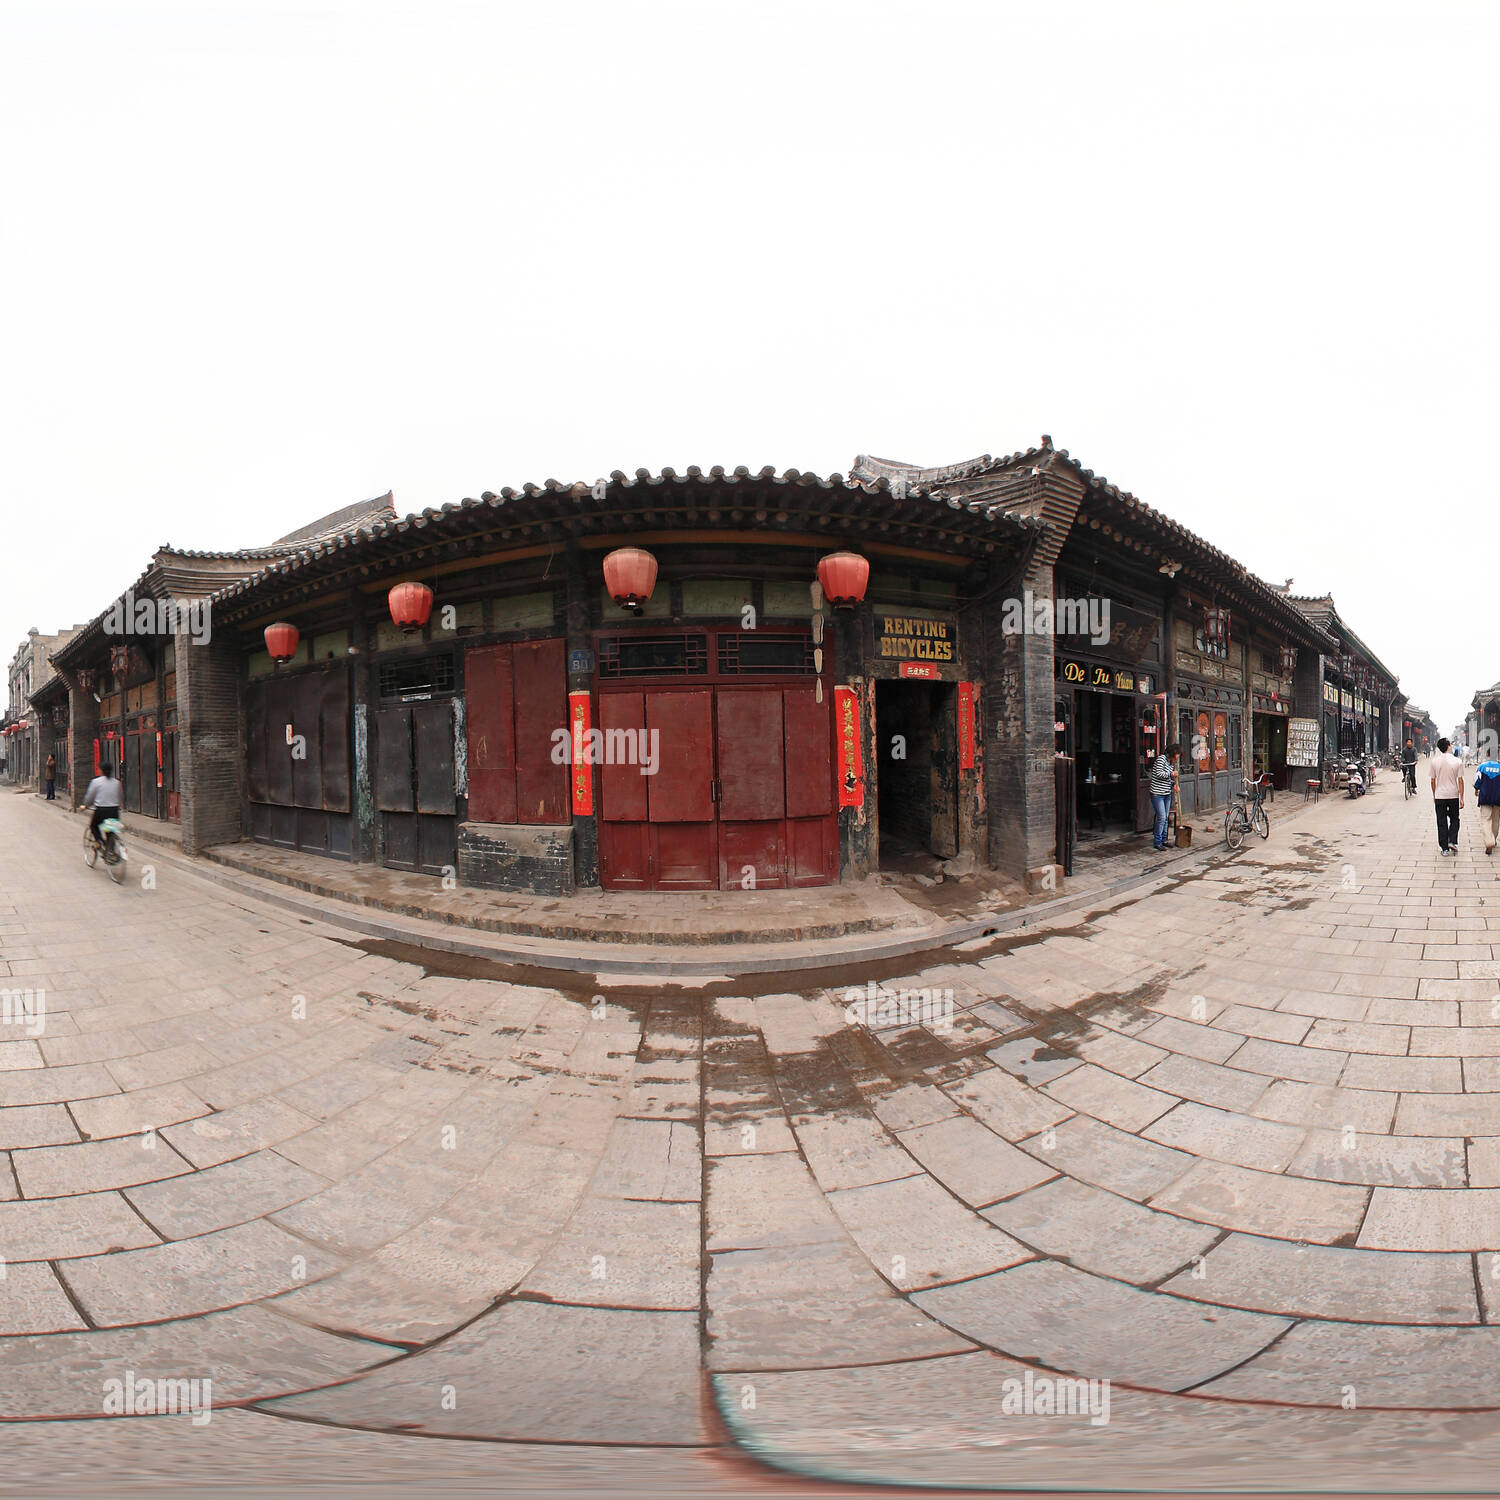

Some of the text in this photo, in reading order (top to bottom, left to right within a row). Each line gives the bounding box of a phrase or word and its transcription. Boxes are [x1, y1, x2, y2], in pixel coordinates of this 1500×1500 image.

[884, 616, 947, 639] RENTING
[880, 637, 952, 660] BICYCLES
[1064, 662, 1134, 691] De Ju Yuan
